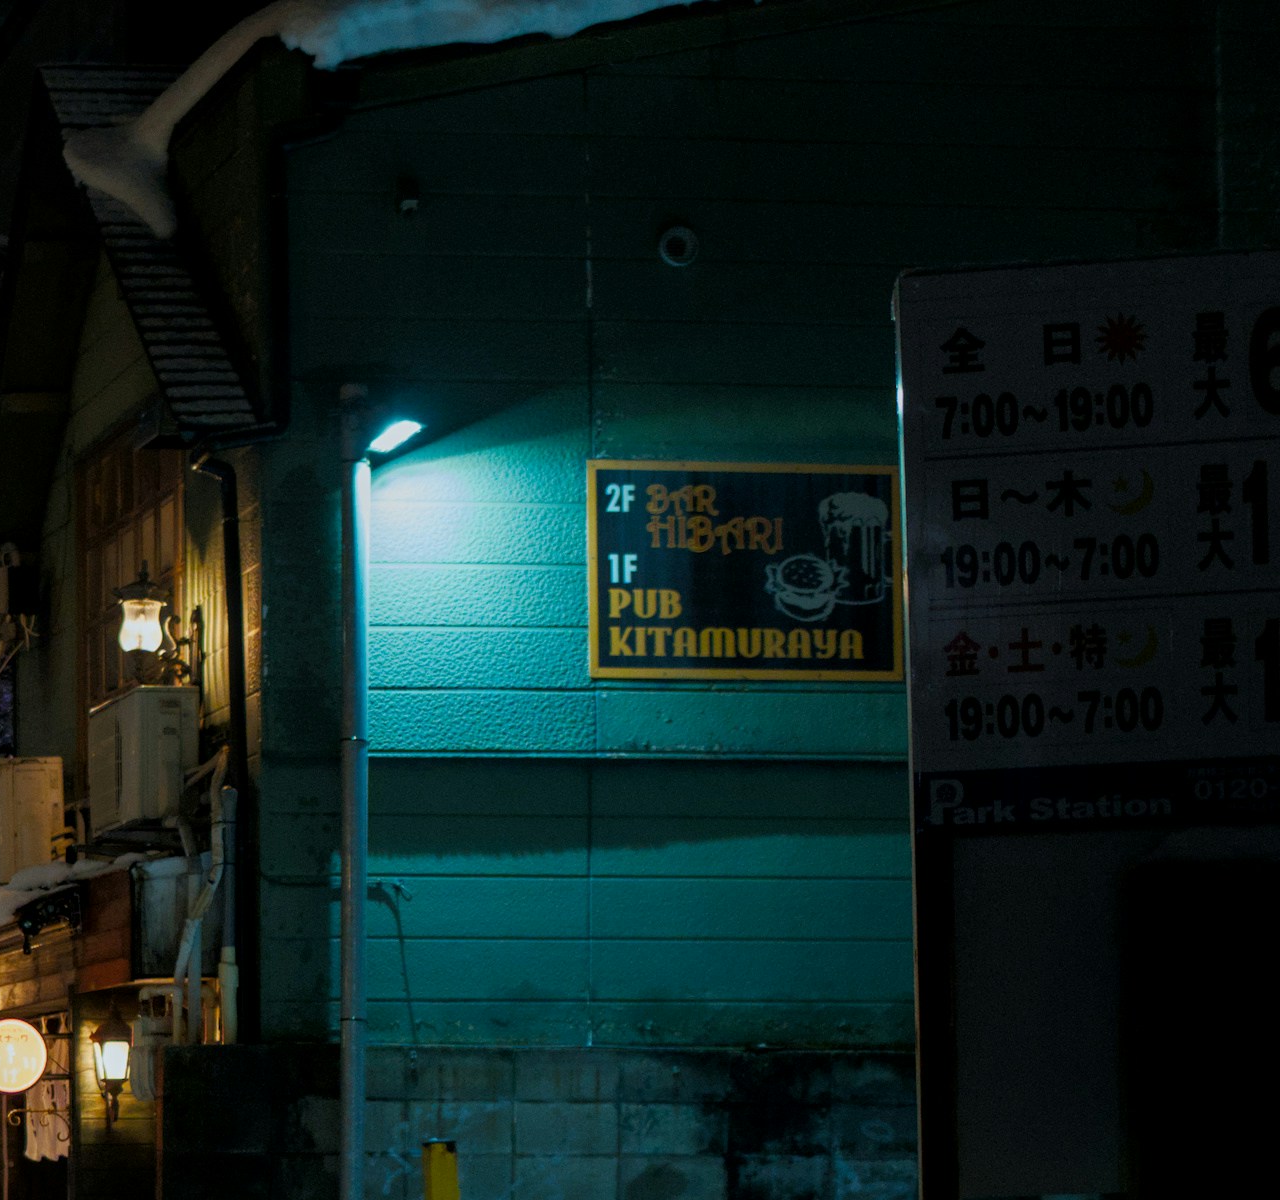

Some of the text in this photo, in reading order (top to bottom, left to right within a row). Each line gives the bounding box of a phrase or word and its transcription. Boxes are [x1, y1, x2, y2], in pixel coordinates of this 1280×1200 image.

[605, 483, 720, 517] 2F BAR
[646, 515, 784, 555] HIBARI
[607, 553, 638, 584] 1F
[607, 588, 683, 620] PUB
[607, 626, 865, 660] KITAMURAYA
[926, 778, 1172, 826] Park Station
